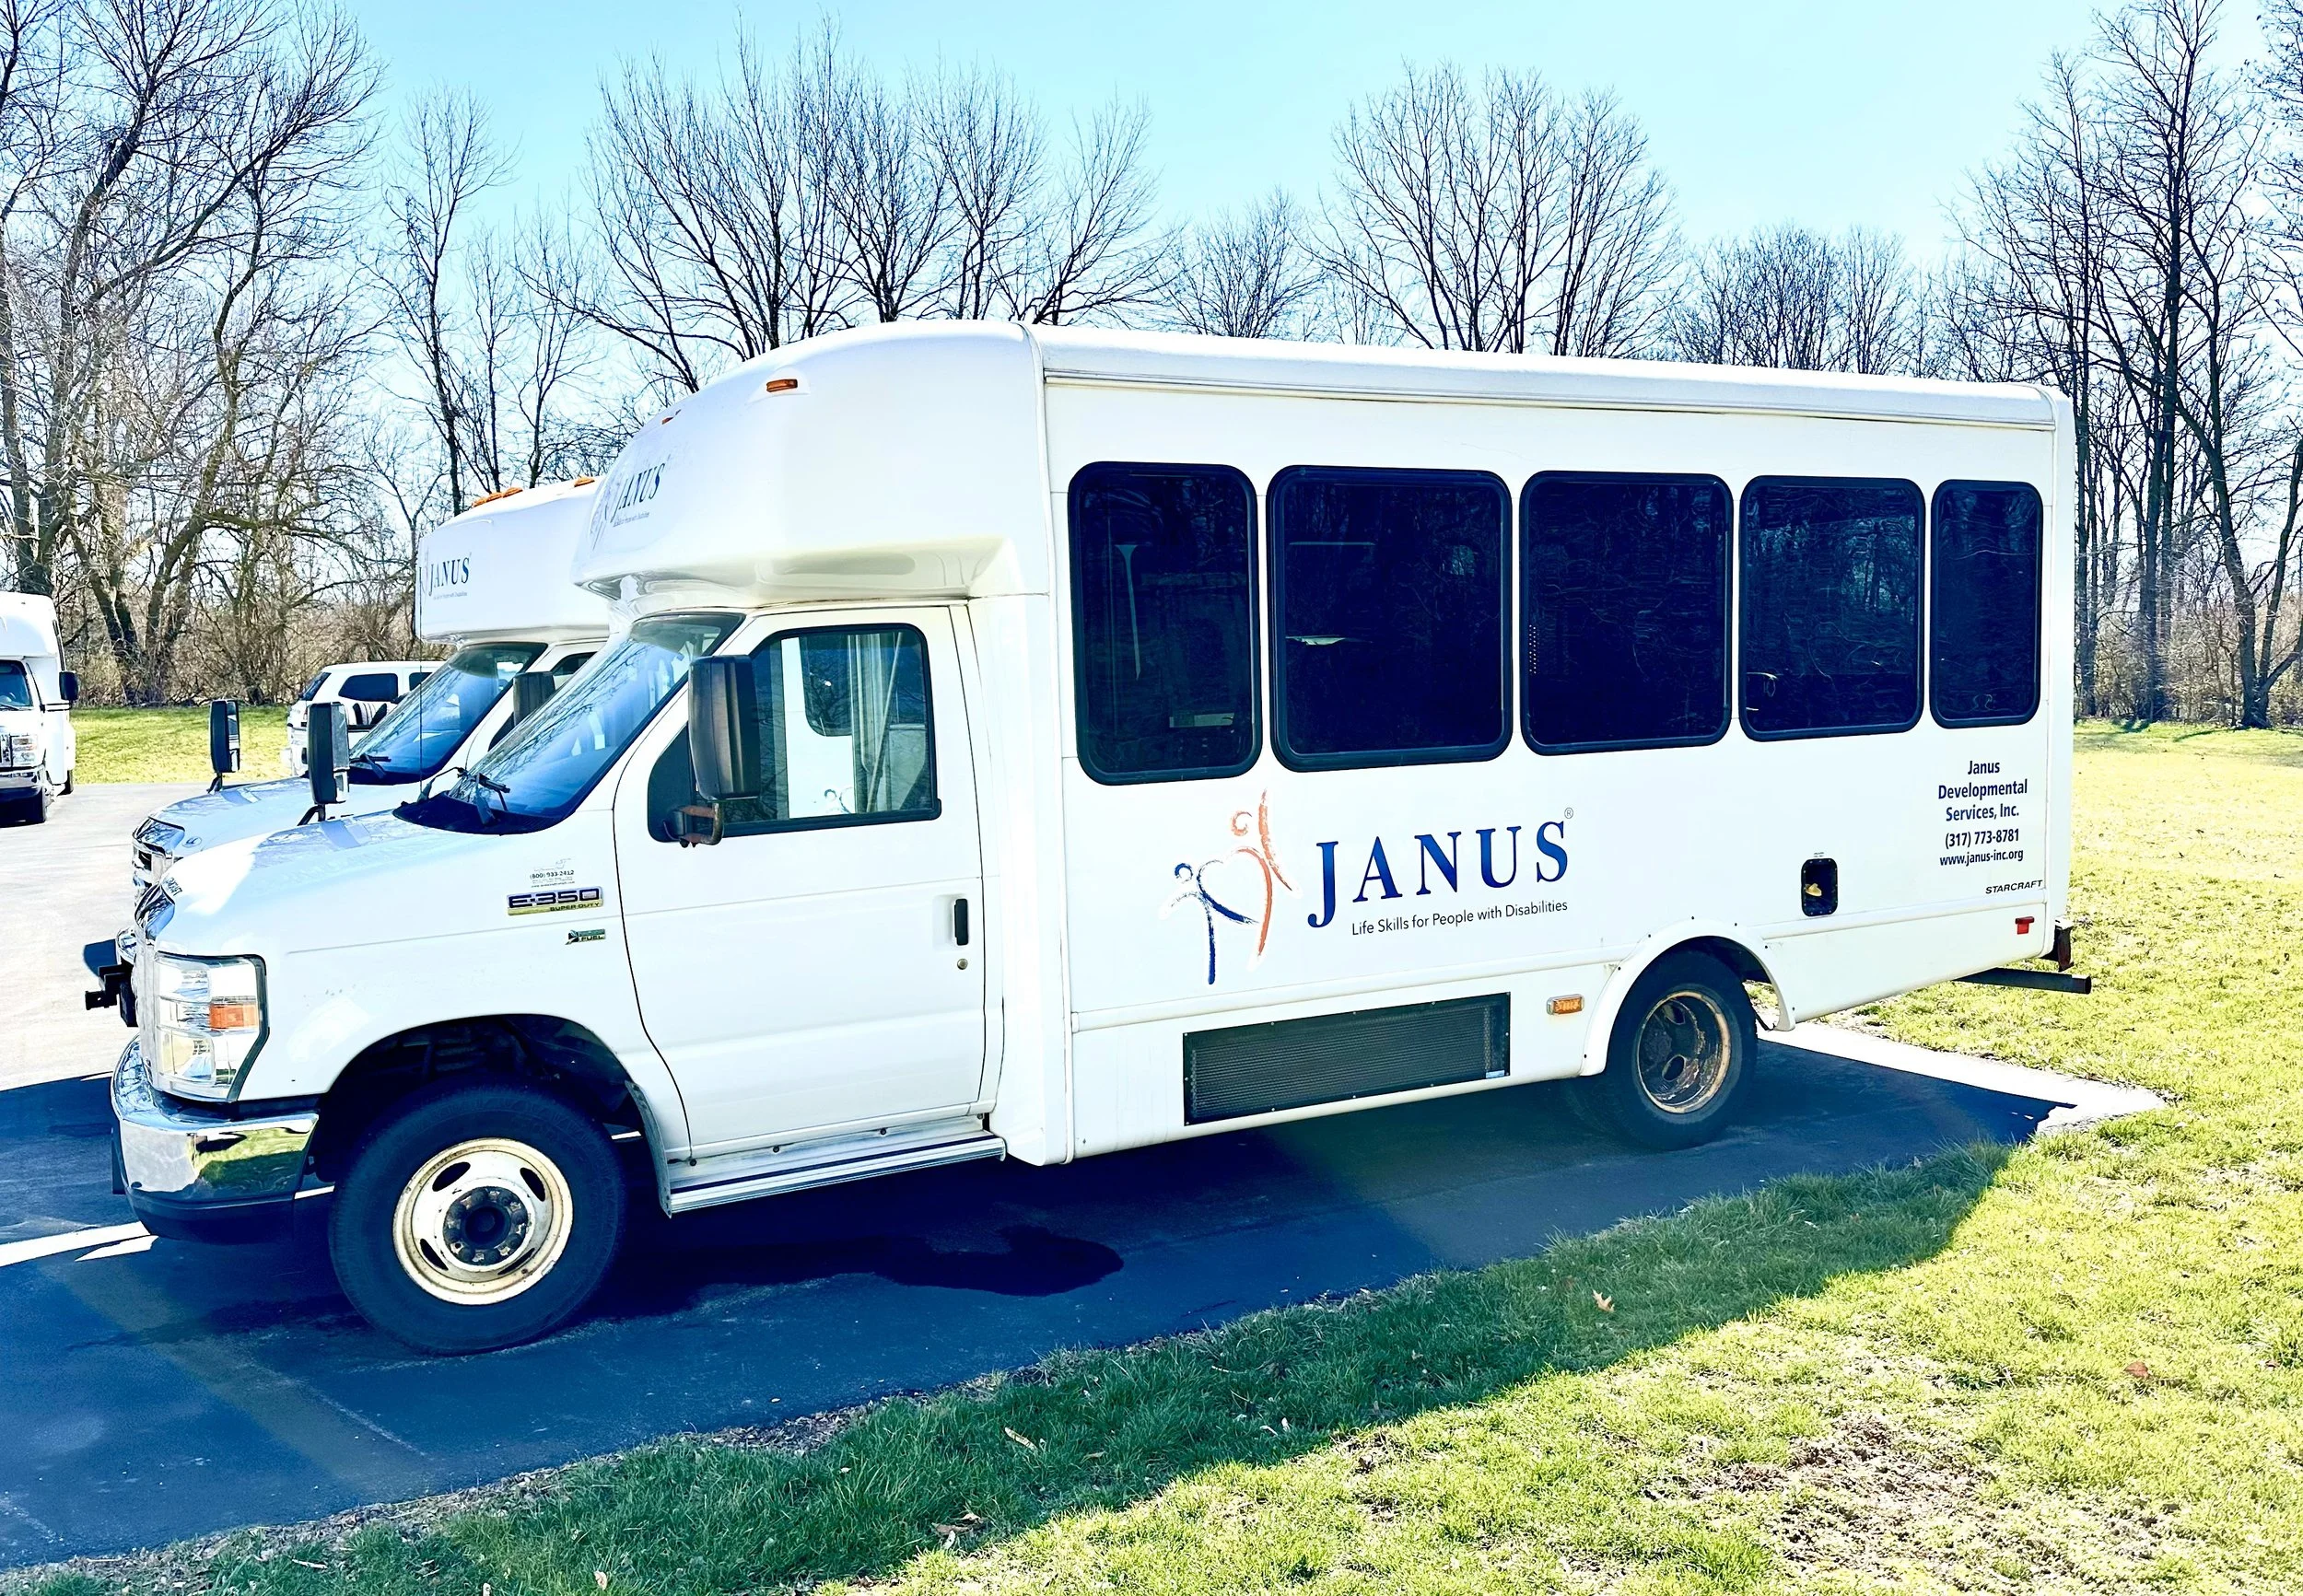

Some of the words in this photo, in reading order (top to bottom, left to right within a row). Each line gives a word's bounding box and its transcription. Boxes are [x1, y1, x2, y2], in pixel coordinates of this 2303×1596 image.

[610, 462, 666, 523] JANUS
[428, 556, 470, 597] JANUS
[1968, 760, 2001, 775] Janus
[1938, 778, 2028, 800] Developmental
[1946, 804, 1997, 821] Services,
[2000, 803, 2019, 818] Inc.
[1945, 832, 1971, 849] (317)
[1974, 828, 2019, 845] 773-8781
[1939, 849, 2024, 867] www.janus-inc.org
[1307, 820, 1568, 928] JANUS
[1985, 880, 2043, 894] STARCRAFT
[1351, 920, 1374, 935] Life
[1378, 917, 1409, 932] Skills
[1412, 914, 1430, 927] for
[1432, 910, 1474, 926] People
[1478, 906, 1502, 920] with
[1505, 900, 1568, 917] Disabilities
